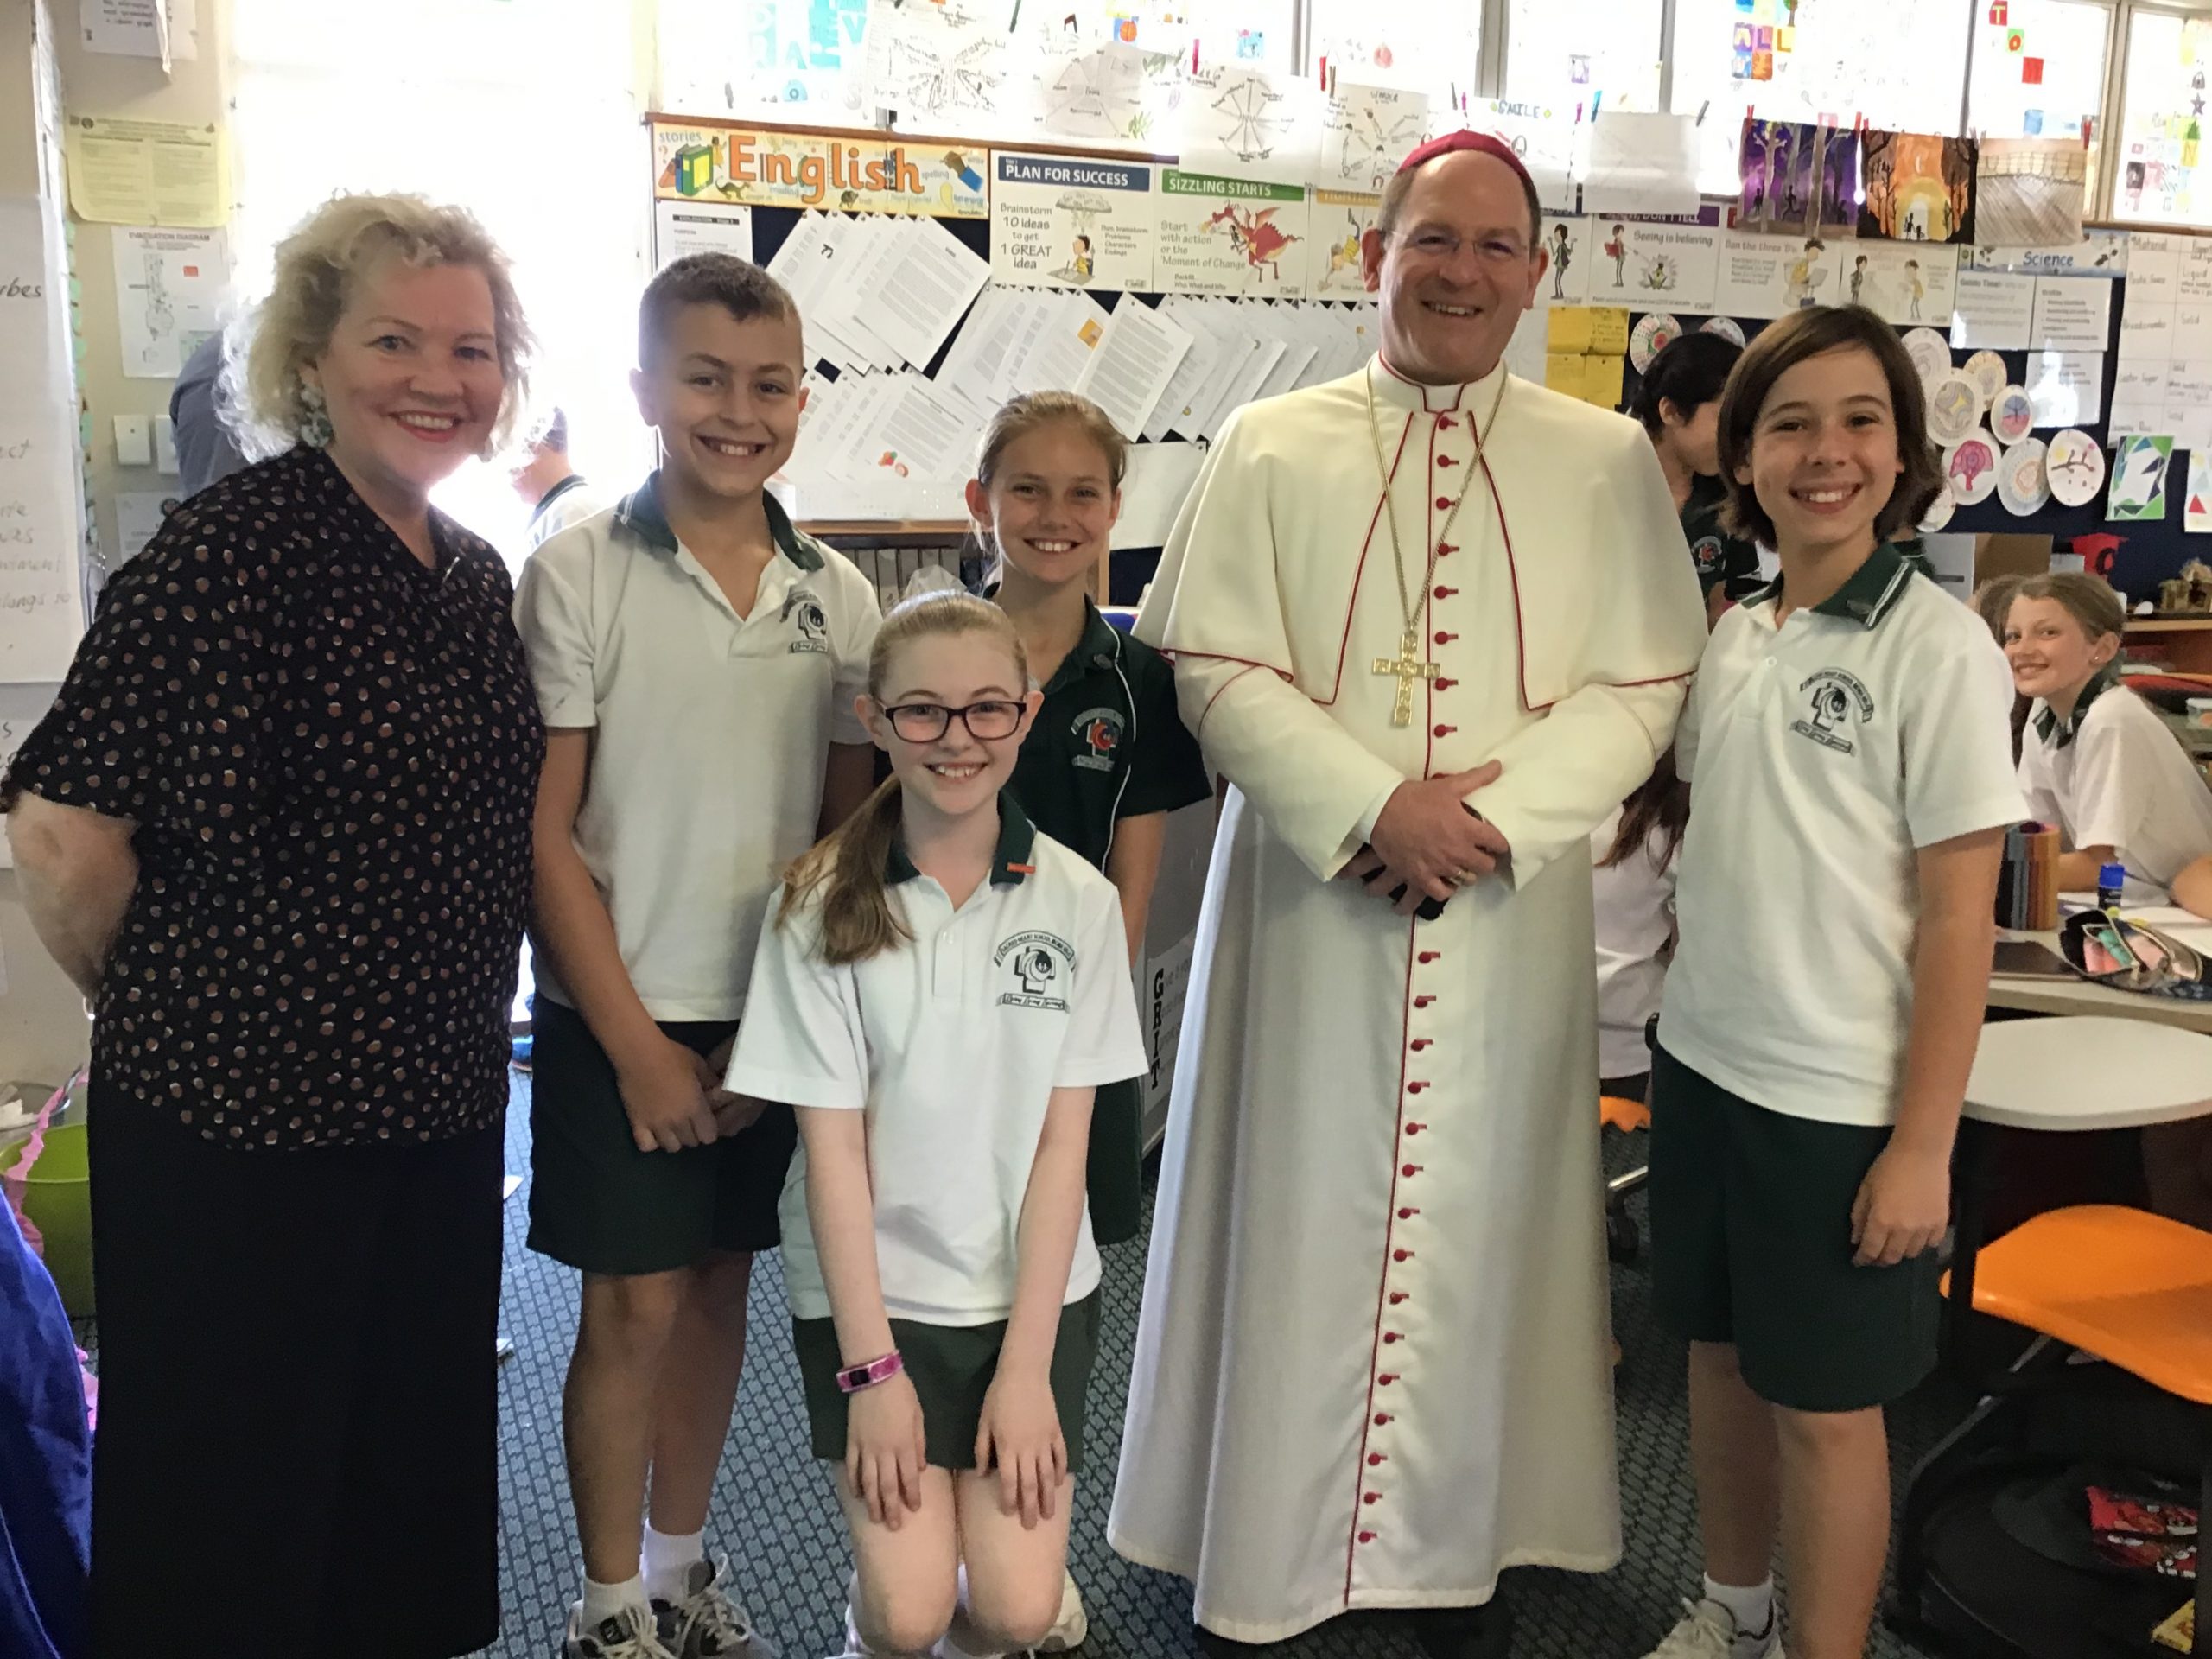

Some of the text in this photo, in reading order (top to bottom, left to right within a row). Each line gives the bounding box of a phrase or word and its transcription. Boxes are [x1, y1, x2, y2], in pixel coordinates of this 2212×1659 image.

[659, 130, 702, 143] stories
[728, 134, 925, 204] English
[1006, 164, 1128, 187] PLAN FOR SUCCESS
[1169, 177, 1272, 197] SIZZLING STARTS
[1001, 202, 1052, 215] Brainstorm
[1003, 216, 1050, 230] 10 ideas
[1161, 220, 1188, 232] Start
[1012, 231, 1039, 243] to get
[1161, 233, 1211, 245] with action
[1633, 230, 1664, 244] Seeing
[1675, 232, 1713, 247] believing
[1001, 243, 1052, 257] 1 GREAT
[1161, 245, 1188, 255] or the
[1014, 257, 1037, 269] idea
[1202, 258, 1211, 268] of
[2023, 251, 2074, 267] Science
[1151, 968, 1164, 1091] GRIT
